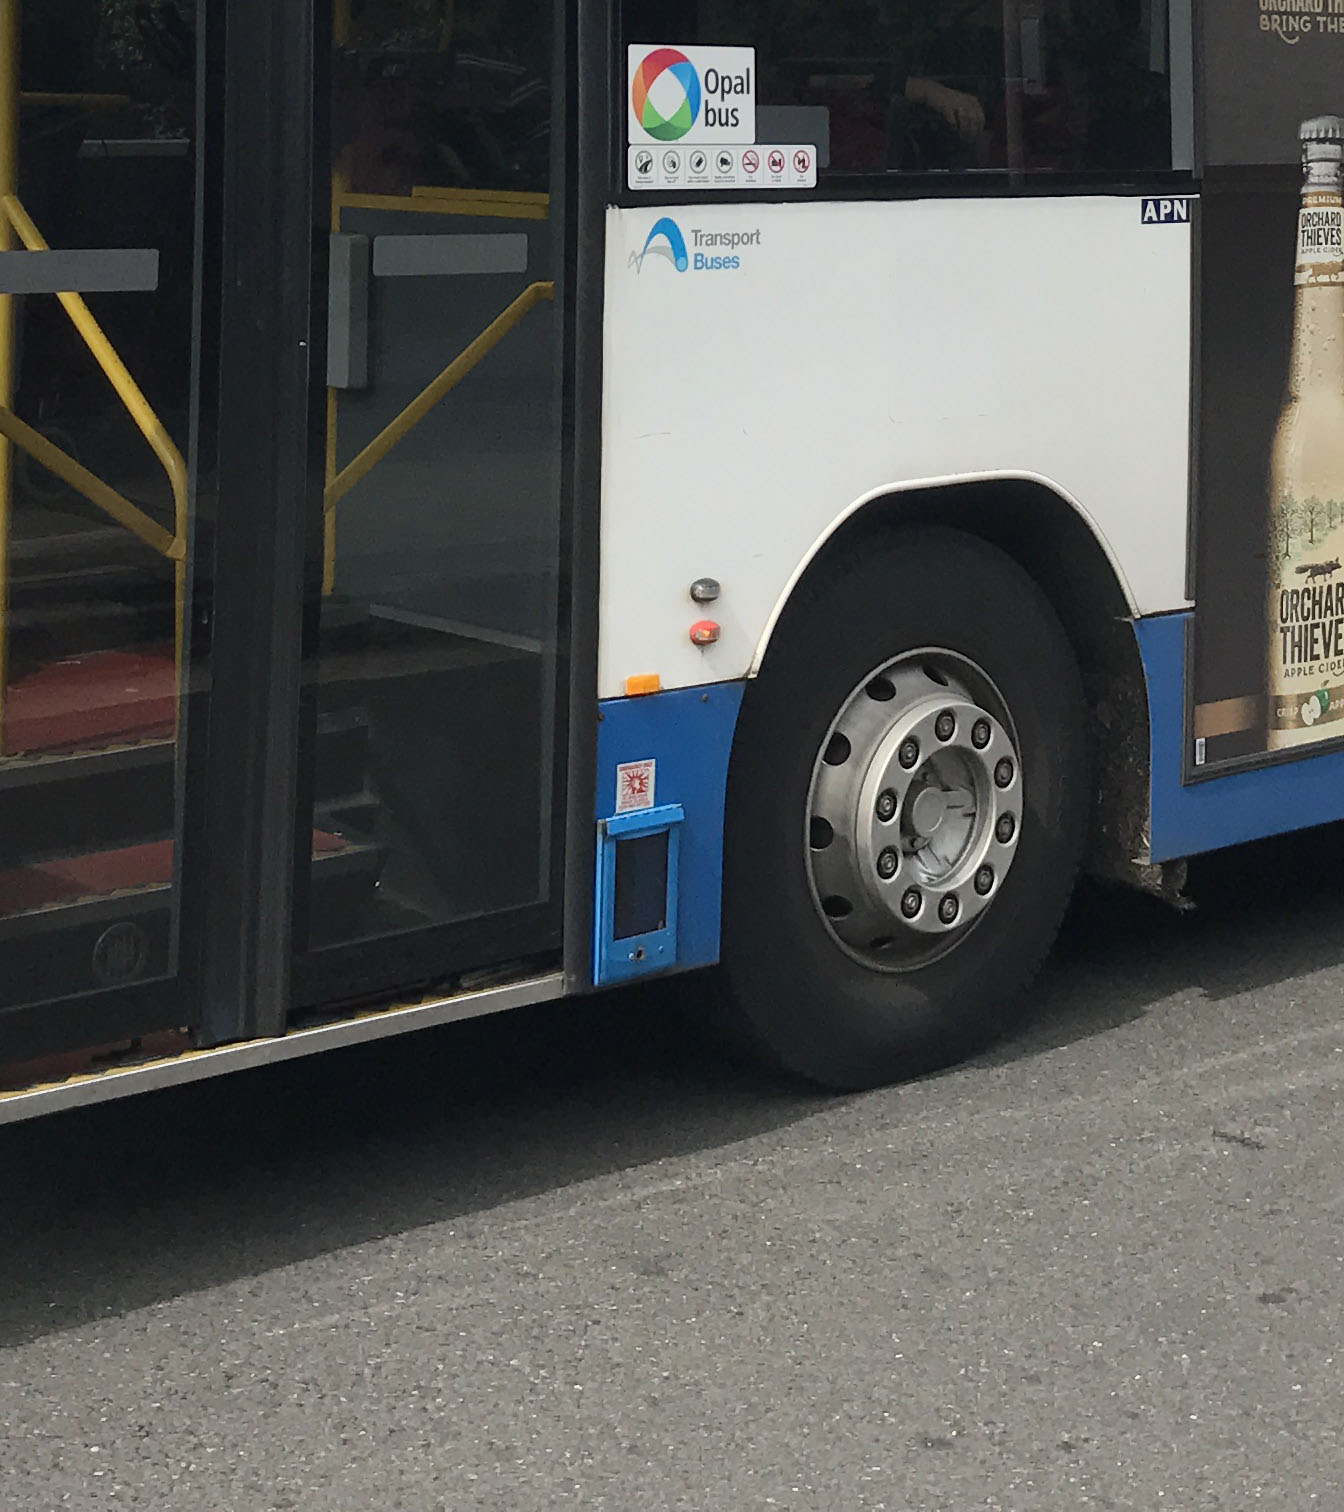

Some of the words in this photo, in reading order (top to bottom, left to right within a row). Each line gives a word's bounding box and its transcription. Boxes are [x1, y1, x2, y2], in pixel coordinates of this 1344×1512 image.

[1259, 14, 1312, 44] BRING
[704, 67, 751, 103] Opal
[705, 99, 740, 128] bus
[1143, 199, 1187, 221] APN
[1301, 211, 1342, 228] ORCHARD
[691, 229, 761, 250] Transport
[1301, 227, 1342, 247] THIEVES
[1301, 247, 1322, 255] APPLE
[694, 252, 740, 271] Buses
[1283, 665, 1315, 678] APPLE
